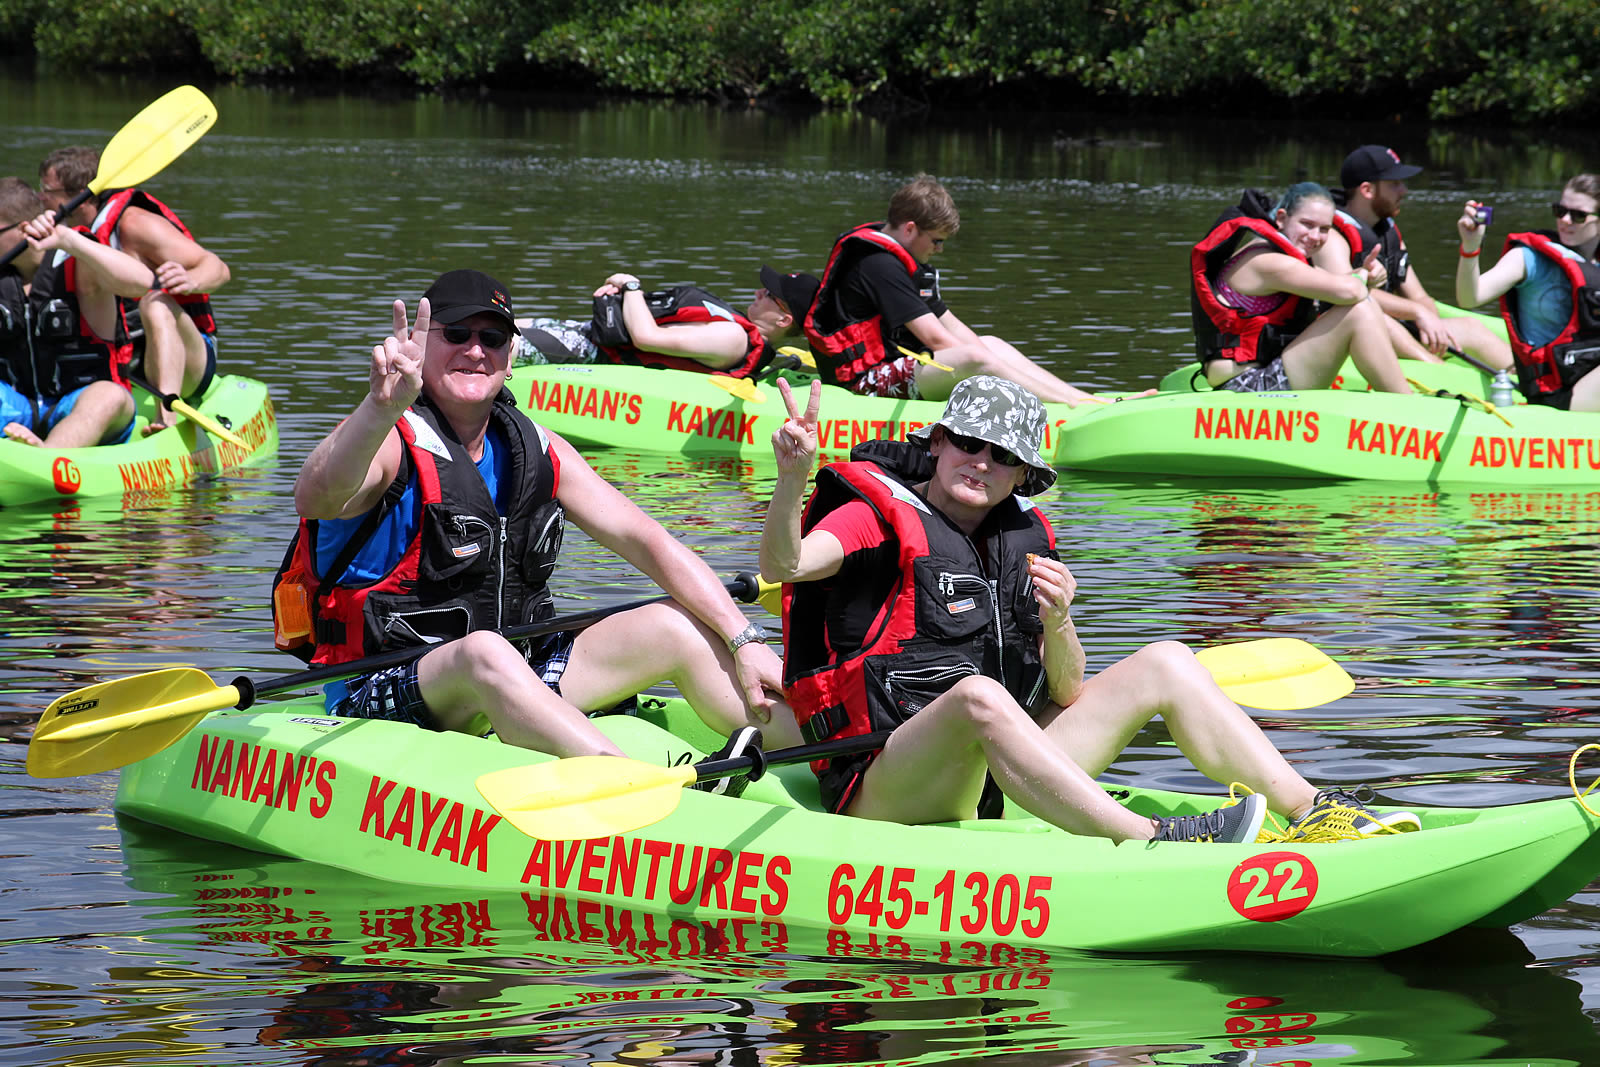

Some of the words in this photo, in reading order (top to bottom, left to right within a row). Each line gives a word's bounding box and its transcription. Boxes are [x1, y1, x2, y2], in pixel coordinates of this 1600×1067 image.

[528, 379, 643, 425] NANAN'S
[666, 401, 759, 445] KAYAK
[1194, 407, 1320, 443] NANAN'S
[1347, 418, 1445, 463] KAYAK
[1469, 436, 1600, 470] ADVENTU
[118, 457, 176, 488] NANAN'S
[191, 734, 337, 818] NANAN'S
[359, 775, 503, 873] KAYAK
[520, 836, 792, 917] AVENTURES
[827, 863, 1053, 939] 645-1305
[1239, 860, 1309, 910] 22
